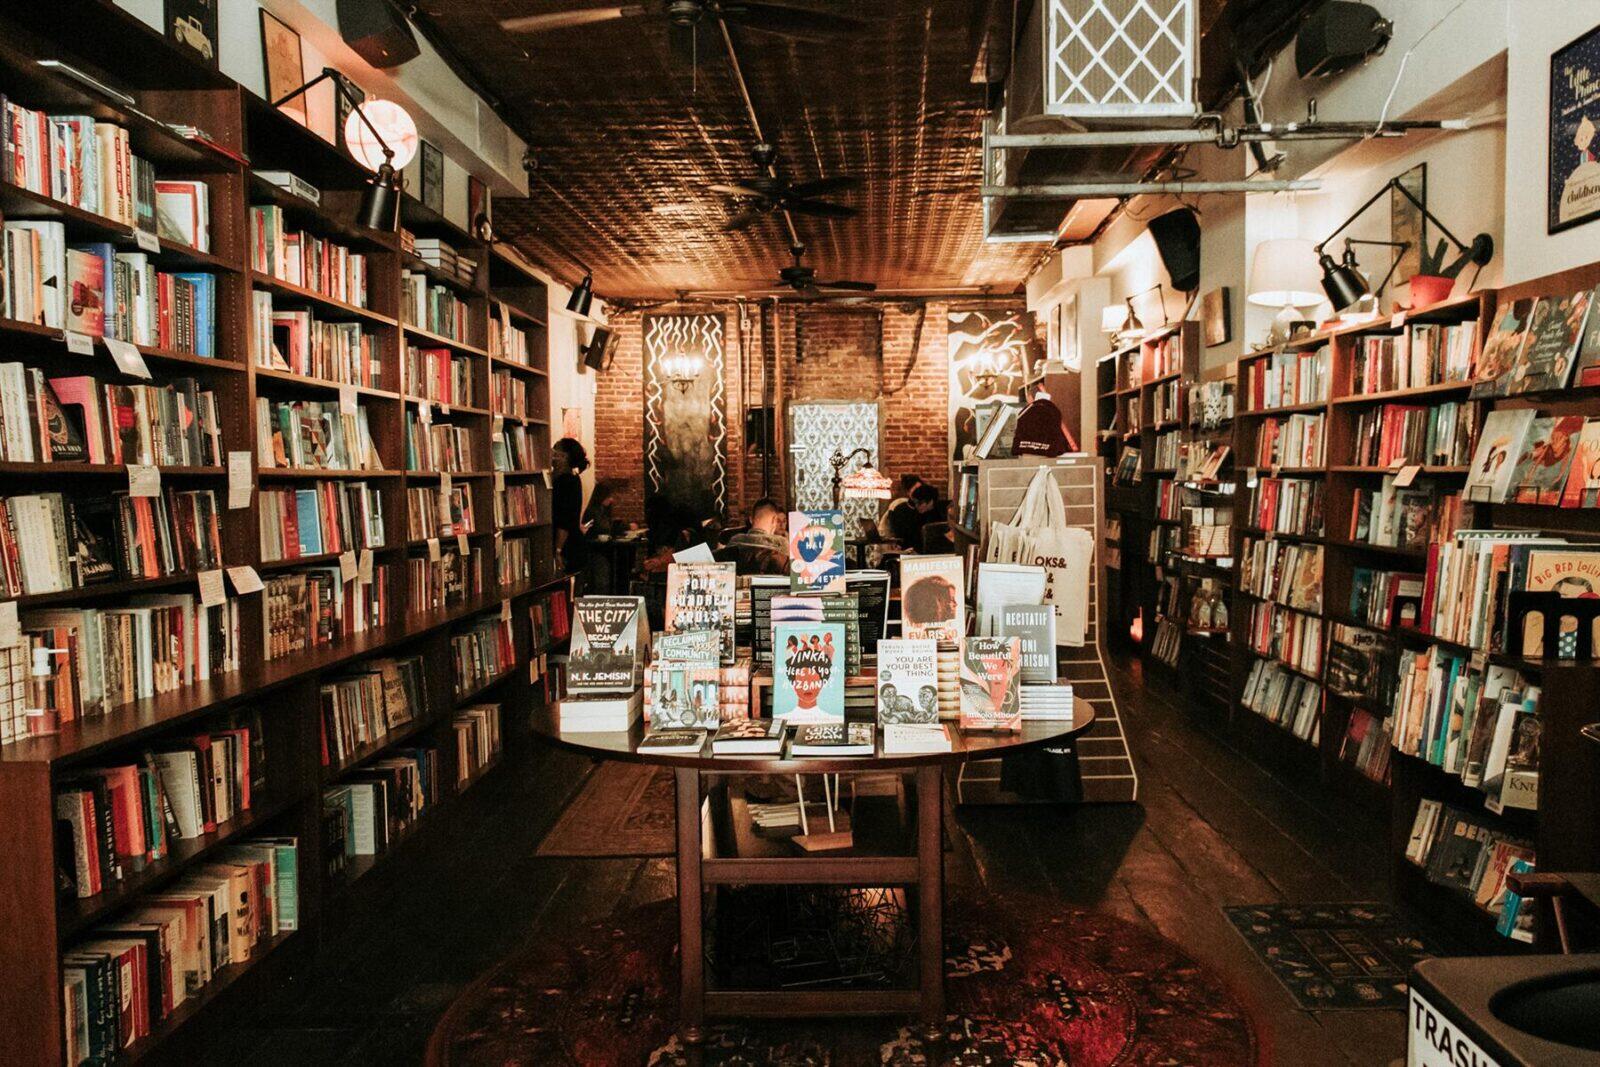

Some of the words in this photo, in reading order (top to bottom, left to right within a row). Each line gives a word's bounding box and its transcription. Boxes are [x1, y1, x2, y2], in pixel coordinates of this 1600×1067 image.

[1534, 569, 1552, 585] BIG
[1555, 562, 1573, 574] RED
[578, 609, 603, 623] THE
[603, 609, 635, 623] CITY
[1005, 612, 1047, 626] RECITATIF
[594, 624, 612, 634] WE
[587, 633, 620, 641] BECAME
[979, 641, 1000, 650] How
[1021, 639, 1037, 653] ONI
[664, 649, 710, 660] COMMUNITY
[791, 650, 829, 665] YINKA,
[968, 651, 1011, 660] Beautiful
[809, 666, 816, 676] IS
[982, 662, 998, 670] We
[592, 672, 631, 681] JEMISIN
[977, 673, 1003, 681] Were
